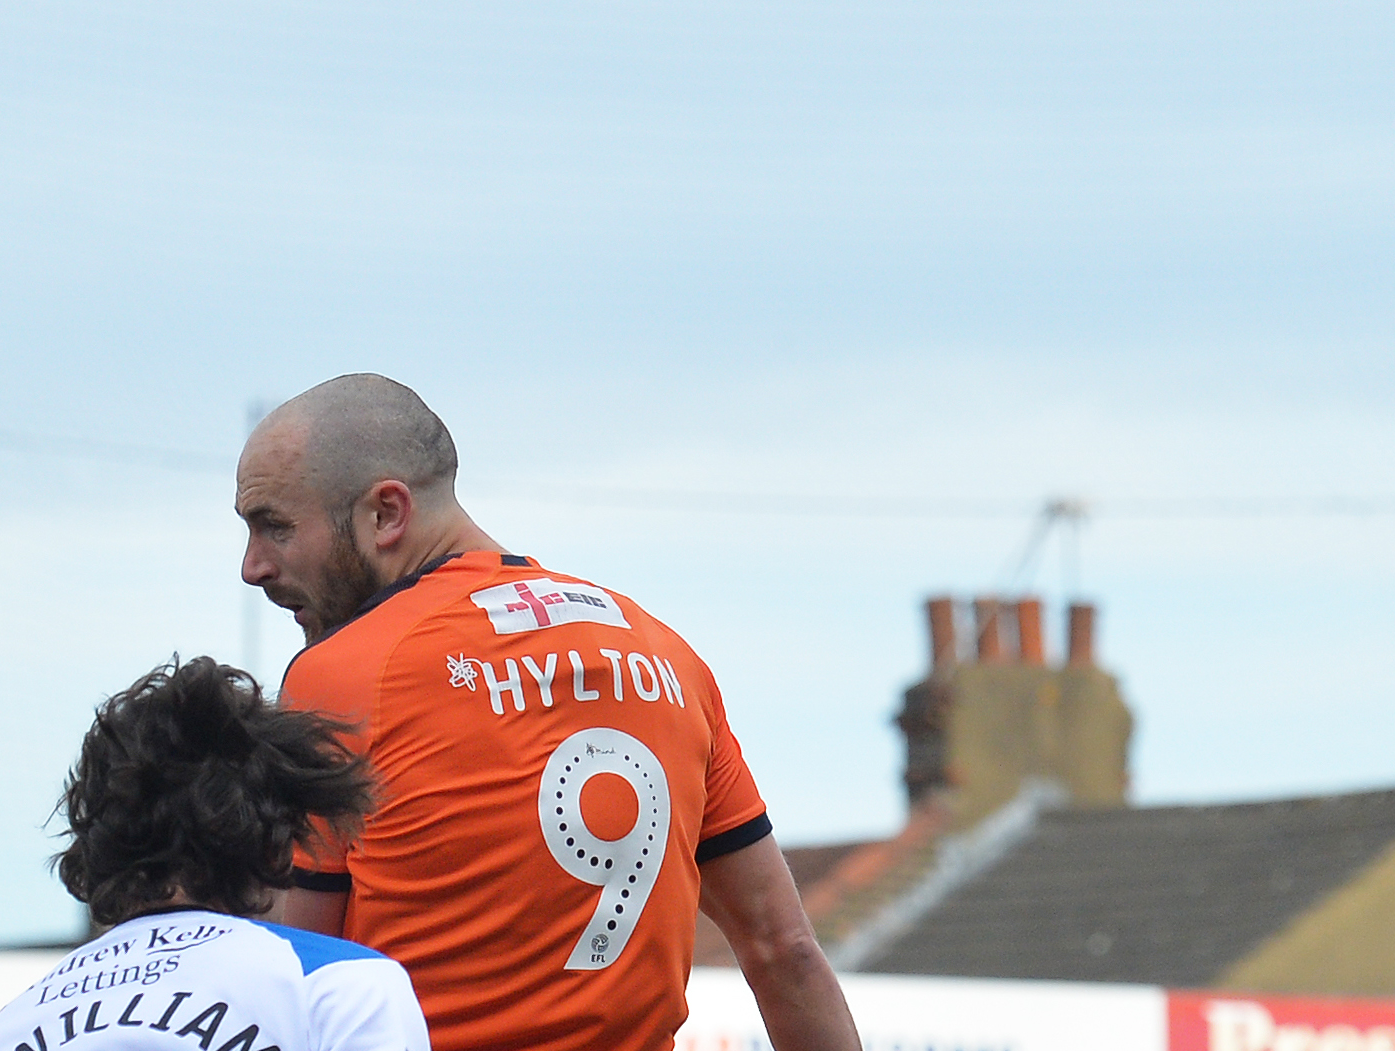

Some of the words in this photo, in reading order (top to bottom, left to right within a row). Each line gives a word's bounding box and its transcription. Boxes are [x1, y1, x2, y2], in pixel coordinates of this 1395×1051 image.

[481, 648, 685, 715] HYLTON
[538, 727, 670, 971] 9
[26, 938, 137, 992] drew
[35, 955, 181, 1007] Lettings
